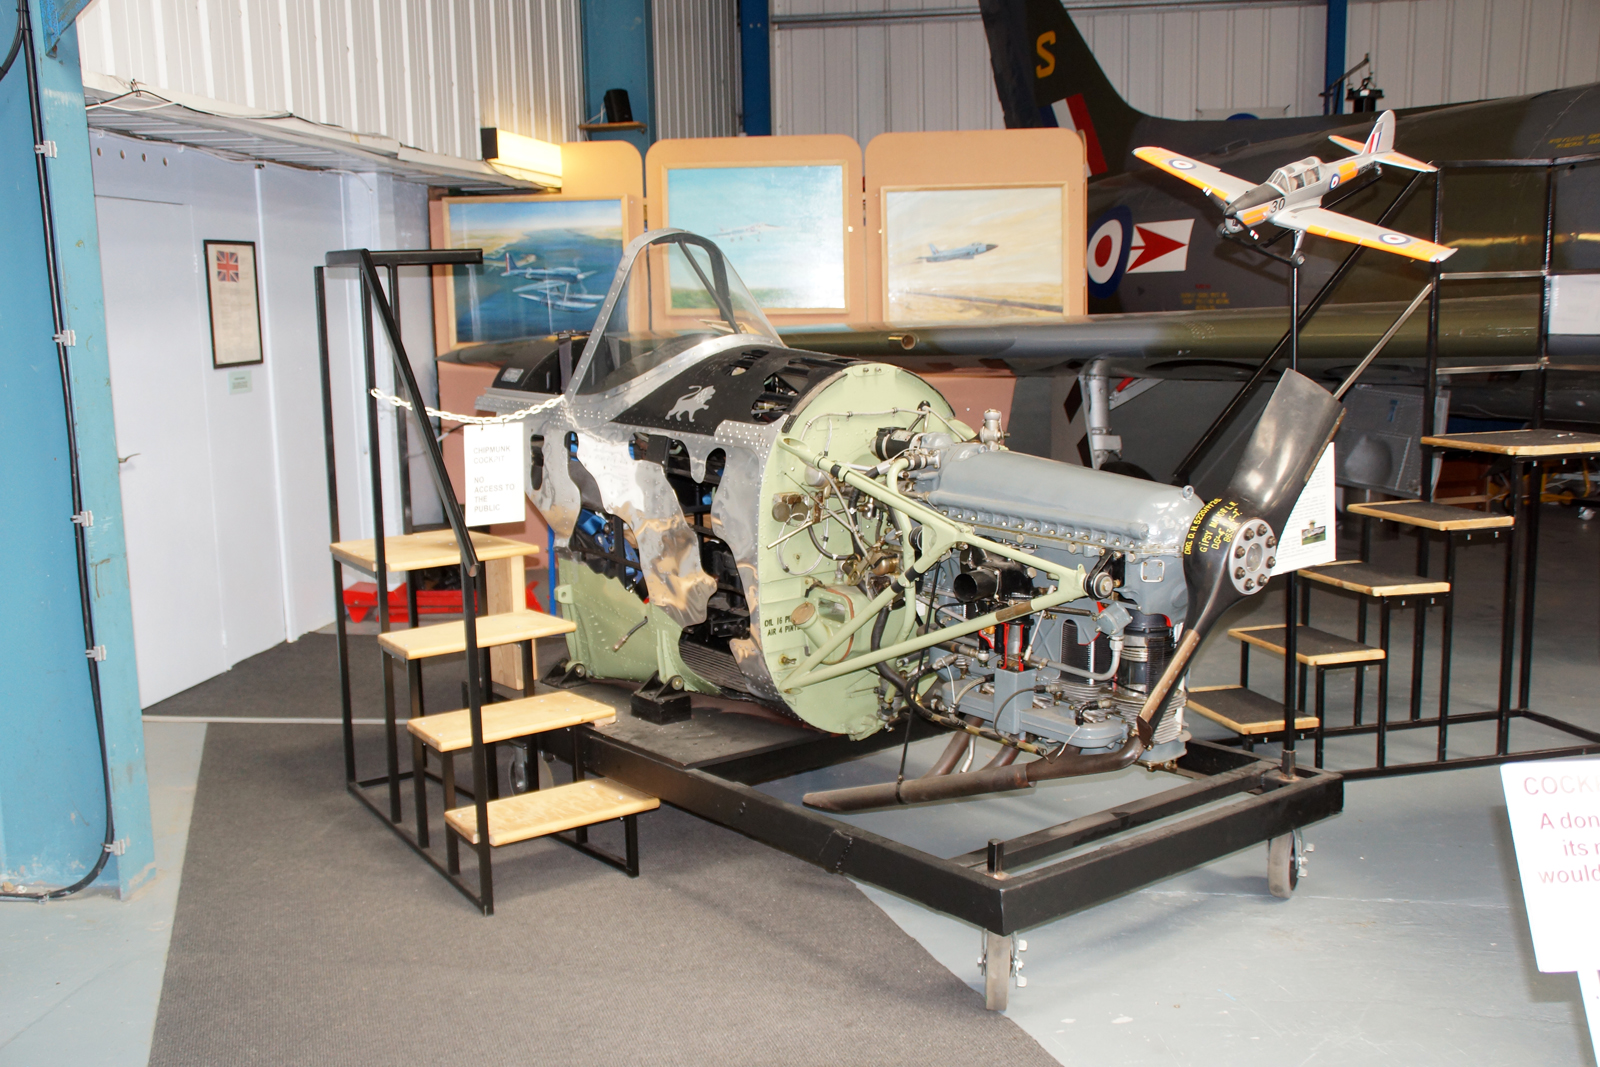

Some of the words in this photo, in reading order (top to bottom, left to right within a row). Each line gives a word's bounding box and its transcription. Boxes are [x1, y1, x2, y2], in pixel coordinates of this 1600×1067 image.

[1036, 30, 1056, 78] S
[1270, 197, 1286, 213] 30
[473, 445, 511, 454] CHIPMUNK
[474, 476, 484, 484] NO
[474, 484, 503, 493] ACCESS
[474, 495, 488, 503] THE
[474, 504, 500, 512] PUBLIC
[764, 619, 774, 627] OIL
[767, 628, 777, 636] AIR
[1540, 812, 1555, 829] A
[1560, 812, 1600, 829] don
[1562, 839, 1589, 856] its
